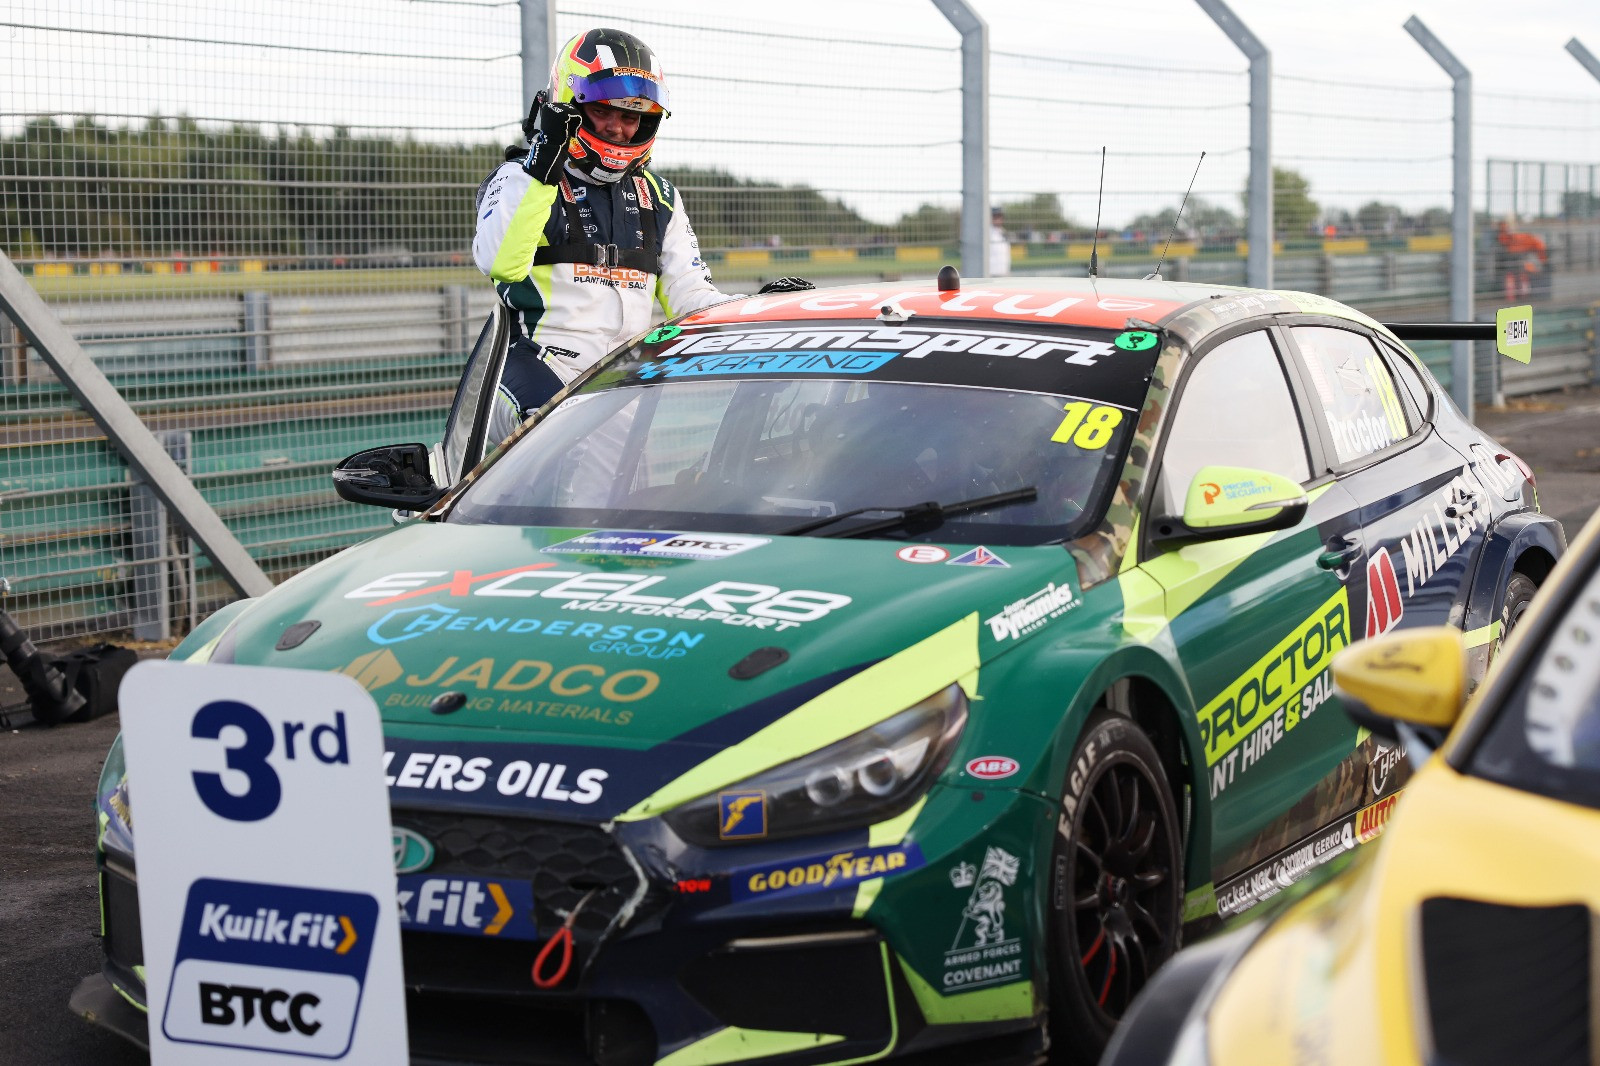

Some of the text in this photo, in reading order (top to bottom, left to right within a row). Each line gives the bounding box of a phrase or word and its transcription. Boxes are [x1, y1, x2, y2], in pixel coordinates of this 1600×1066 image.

[574, 276, 599, 284] PLANT
[576, 264, 648, 280] PROCTOR
[739, 289, 1084, 318] vertu
[683, 354, 882, 373] KARTING
[1365, 355, 1408, 439] 18
[1050, 401, 1123, 450] 18
[1325, 409, 1391, 453] Proctor
[1226, 486, 1272, 499] SECURITY
[664, 538, 744, 550] BTCC
[909, 549, 936, 559] E
[344, 563, 852, 622] EXCELR8
[403, 613, 704, 648] HENDERSON
[561, 600, 800, 632] MOTORSPORT
[1022, 599, 1081, 635] ALLOY WHEELS
[589, 639, 687, 660] GROUP
[405, 656, 660, 703] JADCO
[1200, 603, 1348, 752] PROCTOR
[498, 698, 634, 725] MATERIALS
[191, 700, 349, 822] 3rd
[1209, 747, 1239, 801] NT
[1242, 707, 1284, 773] HIRE
[1285, 694, 1300, 732] &
[496, 760, 609, 804] OILS
[974, 761, 1013, 773] ABS
[1251, 866, 1274, 896] NGK
[1315, 830, 1340, 856] GERKO
[677, 879, 712, 893] TOW
[944, 943, 1021, 967] ARMED FORCES
[943, 959, 1022, 986] COVENANT
[199, 982, 322, 1036] BTCC
